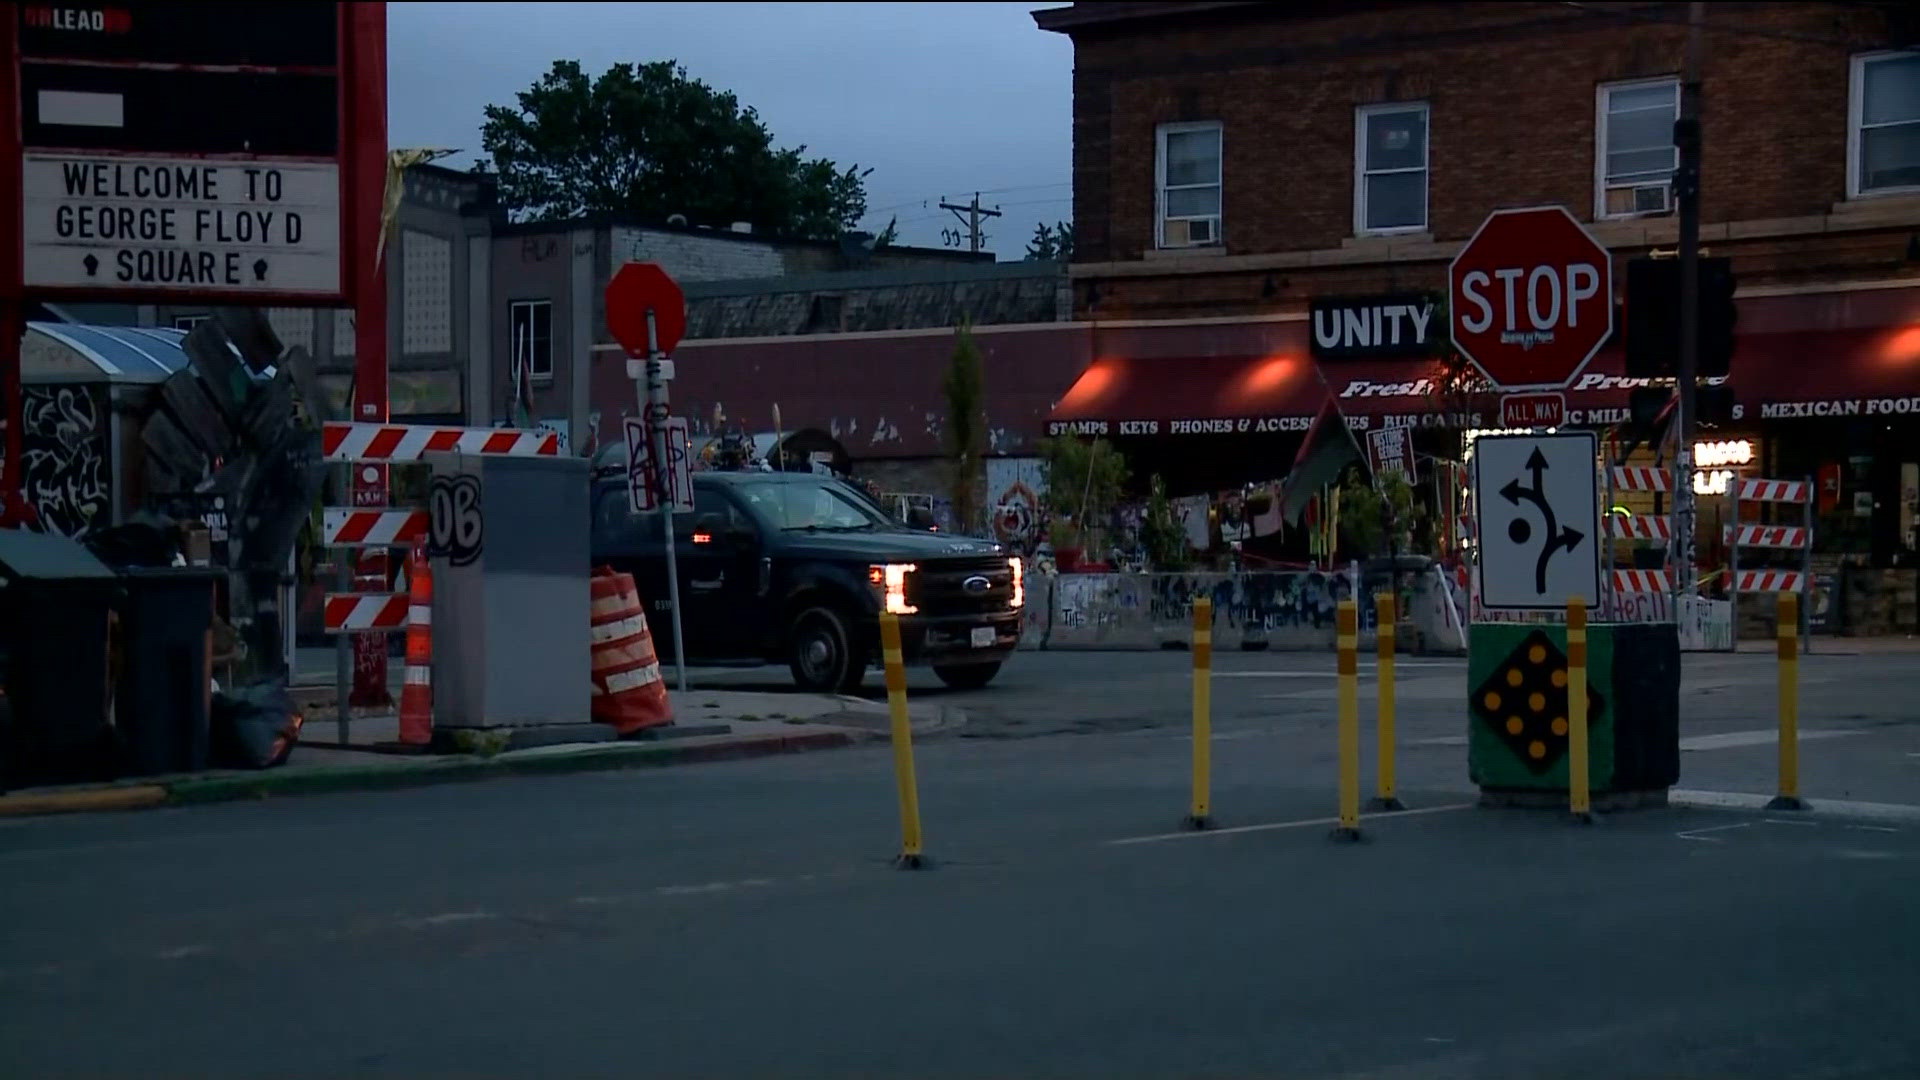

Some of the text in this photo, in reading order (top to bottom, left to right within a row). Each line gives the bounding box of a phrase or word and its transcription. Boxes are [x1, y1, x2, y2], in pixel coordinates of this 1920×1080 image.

[63, 164, 282, 201] WELCOME TO
[57, 206, 175, 240] GEORGE
[117, 250, 240, 284] SQUARE
[1461, 263, 1600, 334] STOP
[1314, 303, 1434, 348] UNITY
[1339, 379, 1434, 398] Fresh
[1049, 420, 1109, 436] STAMPS
[1119, 420, 1159, 435] KEYS
[1170, 418, 1233, 434] PHONES
[1237, 418, 1251, 432] &
[1383, 415, 1418, 429] BUS
[1761, 401, 1860, 419] MEXICAN
[1507, 403, 1532, 422] ALL
[1535, 402, 1559, 420] WAY
